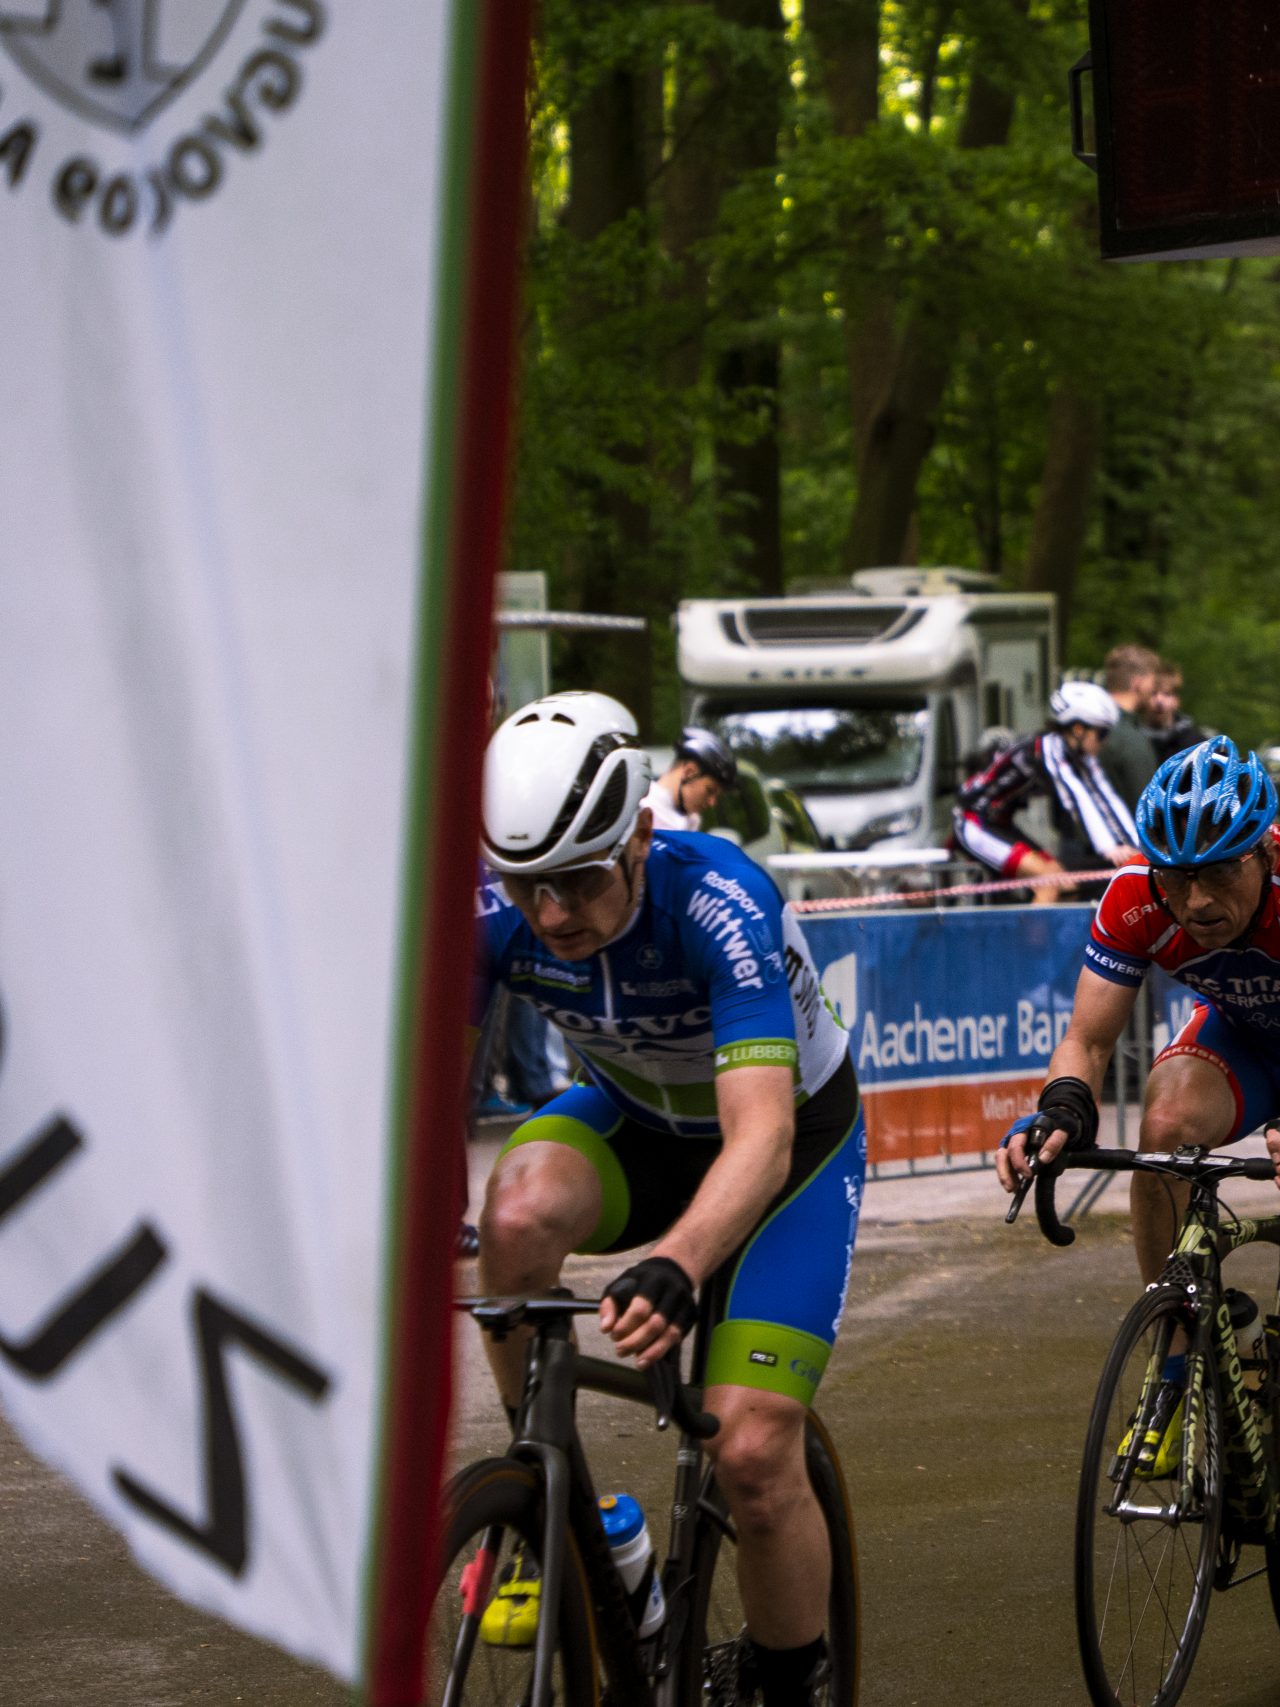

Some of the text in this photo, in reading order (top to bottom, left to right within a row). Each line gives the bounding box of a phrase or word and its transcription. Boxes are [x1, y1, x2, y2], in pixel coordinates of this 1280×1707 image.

[686, 889, 764, 990] Wittwer
[859, 999, 1074, 1070] Aachener Ban
[1216, 1303, 1264, 1464] CIPOLLINI
